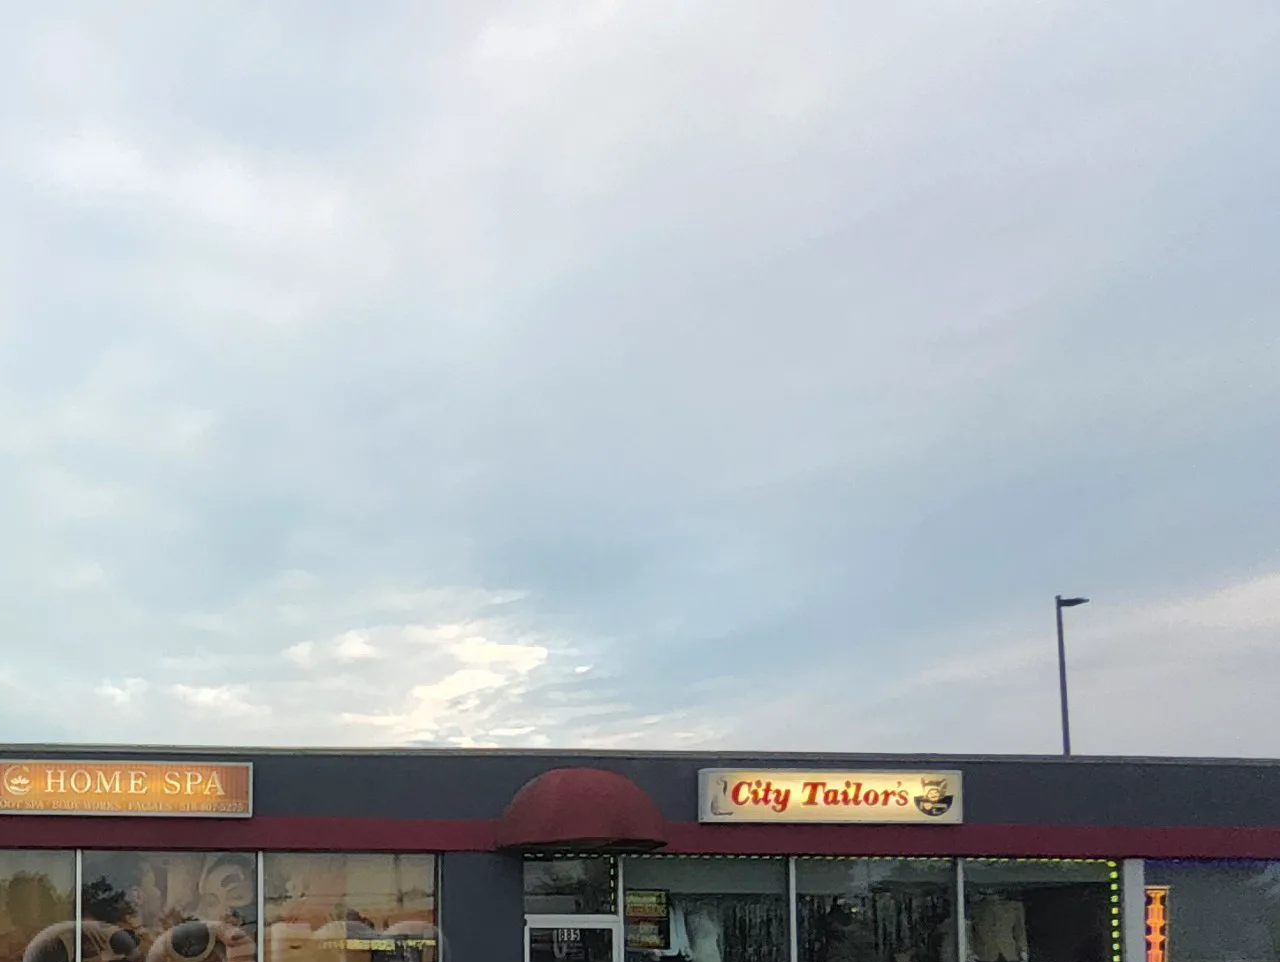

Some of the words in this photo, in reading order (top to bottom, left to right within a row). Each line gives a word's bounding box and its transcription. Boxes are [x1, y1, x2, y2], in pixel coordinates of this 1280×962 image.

[44, 768, 148, 794] HOME
[164, 770, 225, 796] SPA
[731, 780, 790, 812] City
[801, 780, 909, 806] Tailor's
